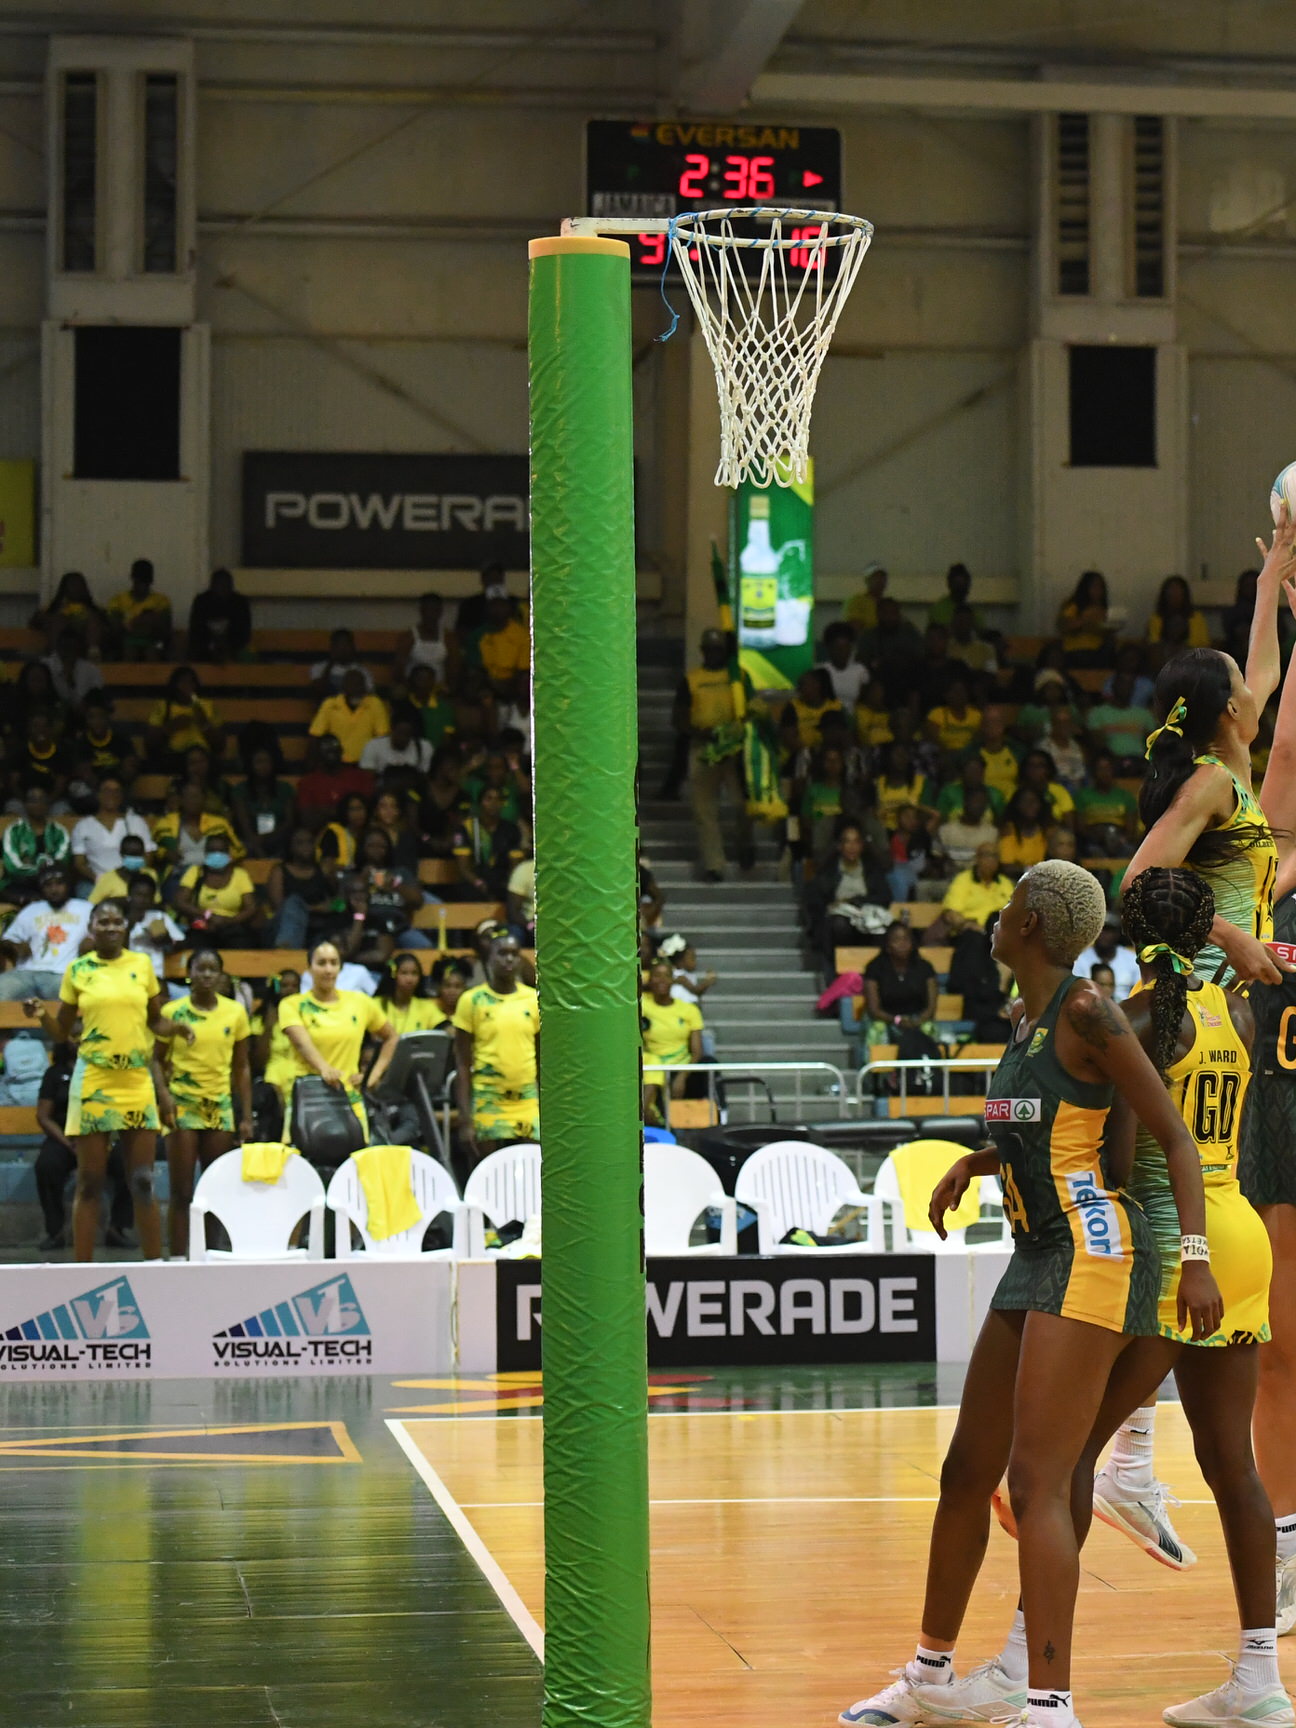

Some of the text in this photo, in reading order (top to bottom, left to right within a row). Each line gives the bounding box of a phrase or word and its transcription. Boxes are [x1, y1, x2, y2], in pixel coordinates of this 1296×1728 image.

[656, 124, 799, 149] EVERSAN
[679, 154, 775, 199] 2:36
[265, 492, 530, 531] POWERA
[1209, 1050, 1237, 1063] WARD
[984, 1103, 1009, 1118] PAR
[1192, 1070, 1241, 1143] GD
[213, 1340, 372, 1358] VISUAL-TECH
[214, 1359, 298, 1367] SOLUTIONS
